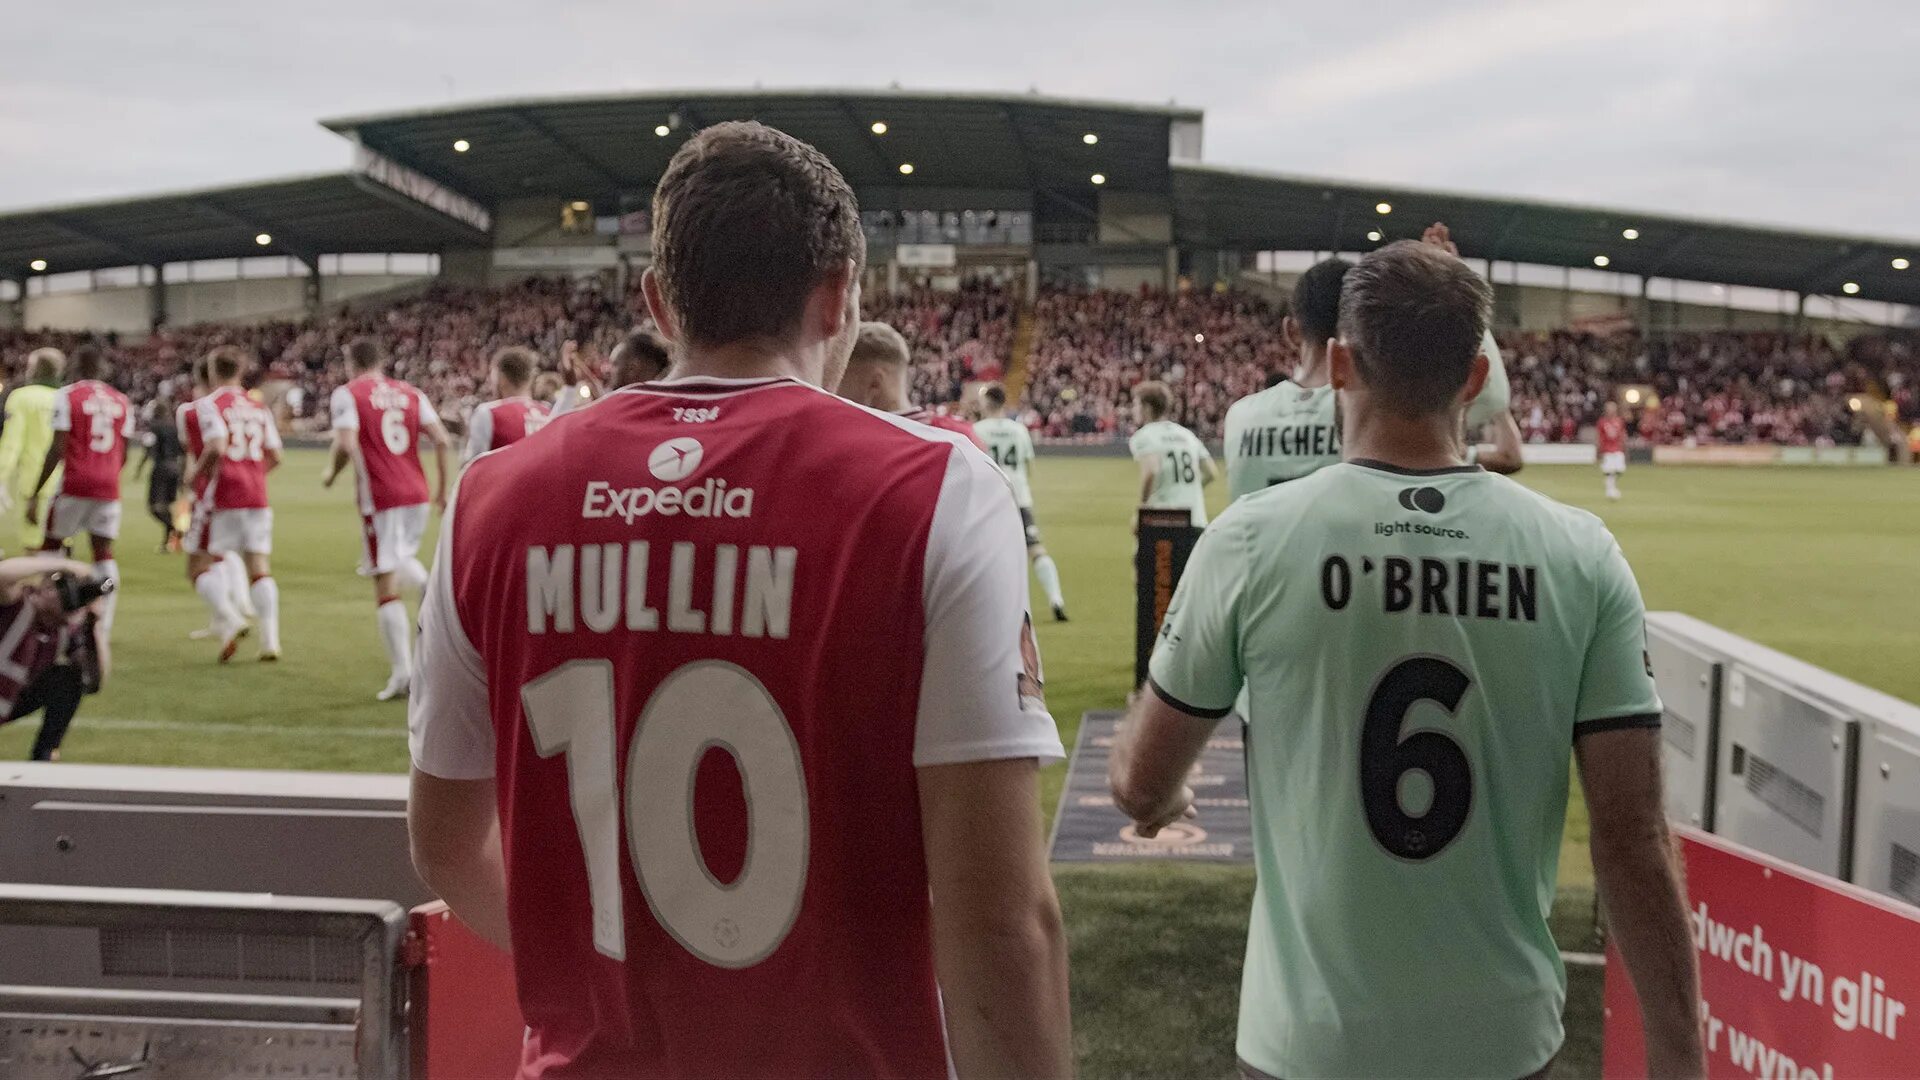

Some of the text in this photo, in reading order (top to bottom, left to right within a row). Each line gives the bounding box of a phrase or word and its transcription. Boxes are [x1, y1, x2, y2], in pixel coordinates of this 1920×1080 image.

[381, 409, 411, 455] 6
[991, 444, 1017, 471] 14
[1167, 450, 1196, 484] 18
[582, 477, 754, 526] Expedia
[1374, 521, 1411, 537] light
[525, 540, 798, 640] MULLIN
[1358, 652, 1475, 865] 6
[519, 657, 812, 970] 10
[1778, 949, 1825, 1007] yn
[1830, 970, 1906, 1041] glir
